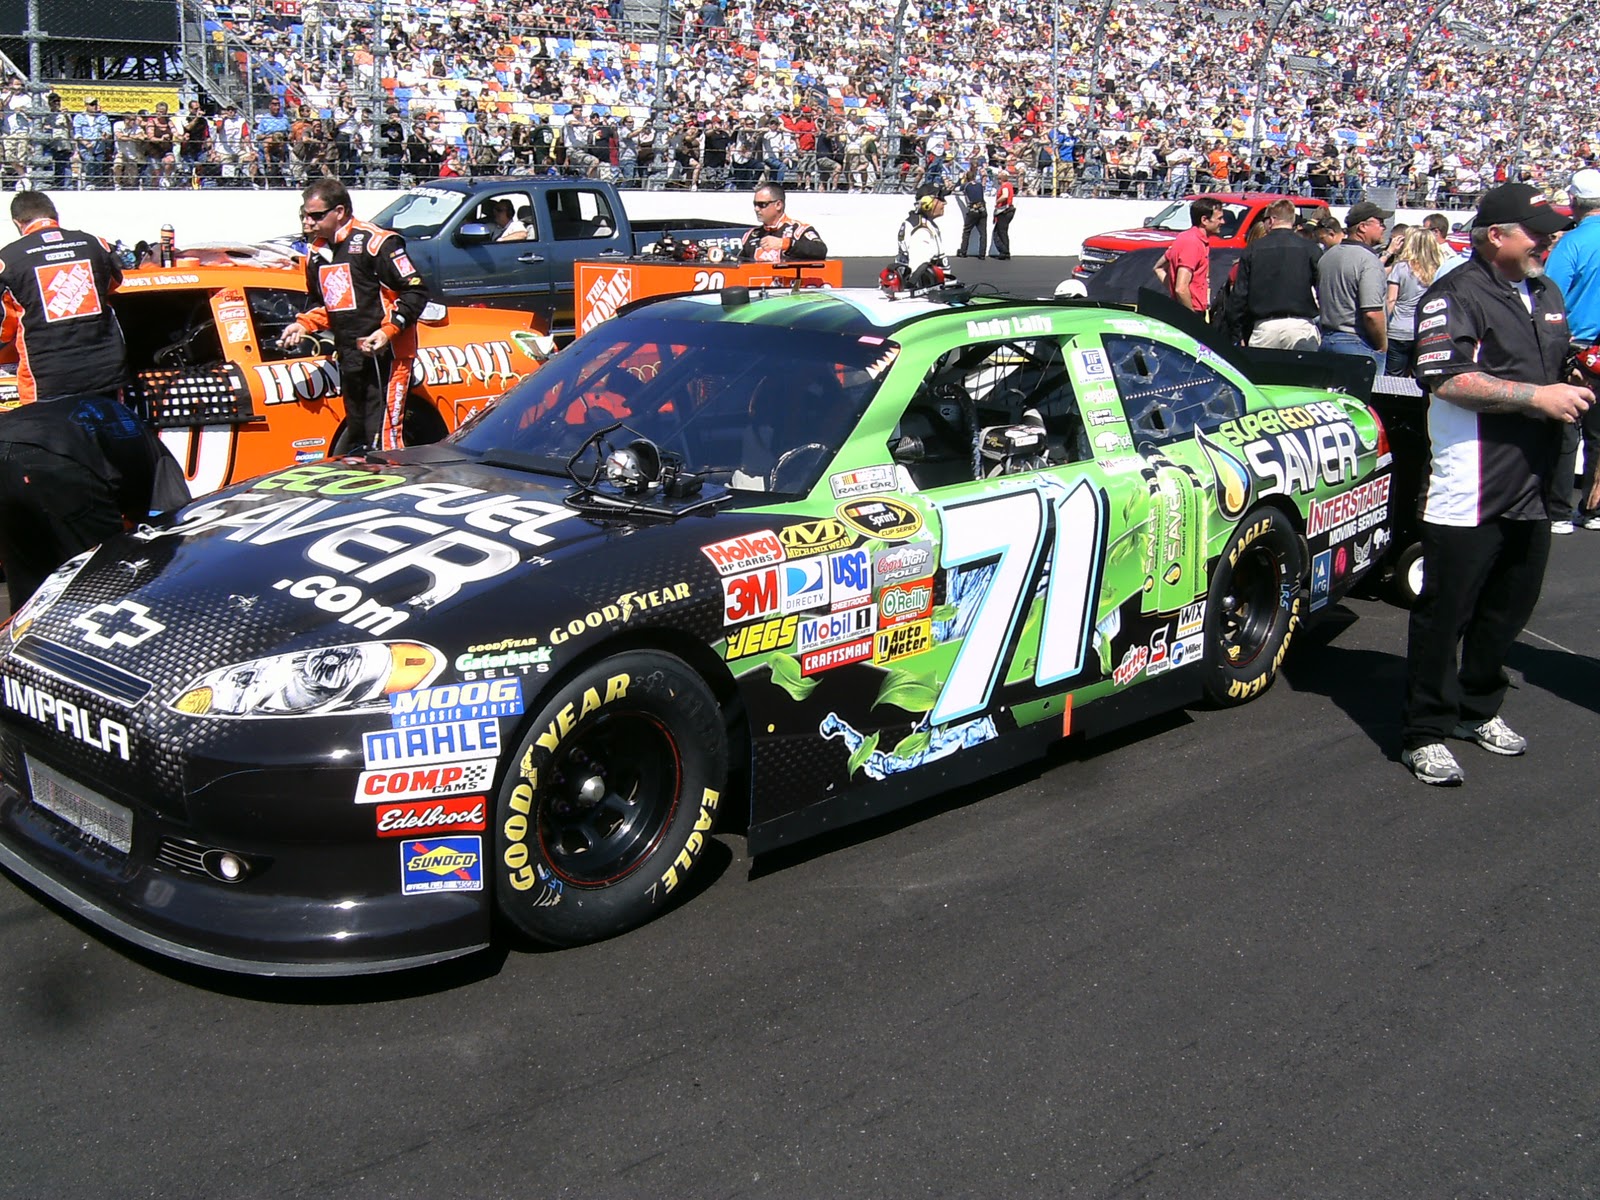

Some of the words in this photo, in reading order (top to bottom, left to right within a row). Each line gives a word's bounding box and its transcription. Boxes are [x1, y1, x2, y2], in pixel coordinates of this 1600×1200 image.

[585, 275, 609, 304] THE
[692, 270, 726, 291] 20
[966, 318, 1011, 338] Andy
[1011, 315, 1053, 335] Lally
[1244, 422, 1358, 499] SAVER
[253, 466, 407, 496] ECO
[838, 484, 869, 495] RACE
[870, 481, 892, 490] CAR
[362, 482, 582, 547] FUEL
[868, 511, 898, 527] Sprint
[1307, 474, 1391, 540] INTERSTATE
[881, 528, 895, 537] CUP
[895, 524, 917, 533] SERIES
[1329, 520, 1357, 547] MOVING
[1357, 506, 1388, 532] SERVICES
[143, 493, 521, 611] SAVER
[705, 535, 783, 565] Holley
[785, 544, 829, 559] MECHANIX
[828, 537, 853, 550] WEAR
[1228, 517, 1271, 569] EAGLE
[737, 554, 774, 569] CARBS
[831, 550, 869, 592] USG
[884, 566, 922, 582] POLE
[271, 575, 411, 637] .com
[726, 569, 778, 621] 3M
[786, 593, 825, 610] DIRECTV
[883, 588, 931, 616] O'Reilly
[930, 475, 1101, 727] 71
[549, 581, 691, 646] GOODYEAR
[1180, 603, 1204, 626] WIX
[725, 615, 798, 661] JEGS
[802, 612, 852, 645] Mobil
[891, 624, 922, 643] Auto
[455, 646, 553, 672] Gatorback
[467, 638, 537, 653] GOODYEAR
[804, 642, 871, 671] CRAFTSMAN
[888, 636, 928, 657] Meter
[1185, 643, 1202, 655] Miller
[464, 664, 550, 681] BELTS
[1113, 645, 1148, 684] Turtle
[391, 678, 516, 716] MOOG
[3, 673, 130, 761] IMPALA
[400, 707, 462, 727] CHASSIS
[471, 702, 516, 718] PARTS
[366, 720, 498, 762] MAHLE
[363, 767, 463, 796] COMP
[431, 781, 478, 795] CAMS
[503, 672, 631, 891] GOODYEAR
[376, 803, 484, 832] Edelbrock
[661, 787, 721, 895] EAGLE
[411, 854, 474, 869] SUNOCO
